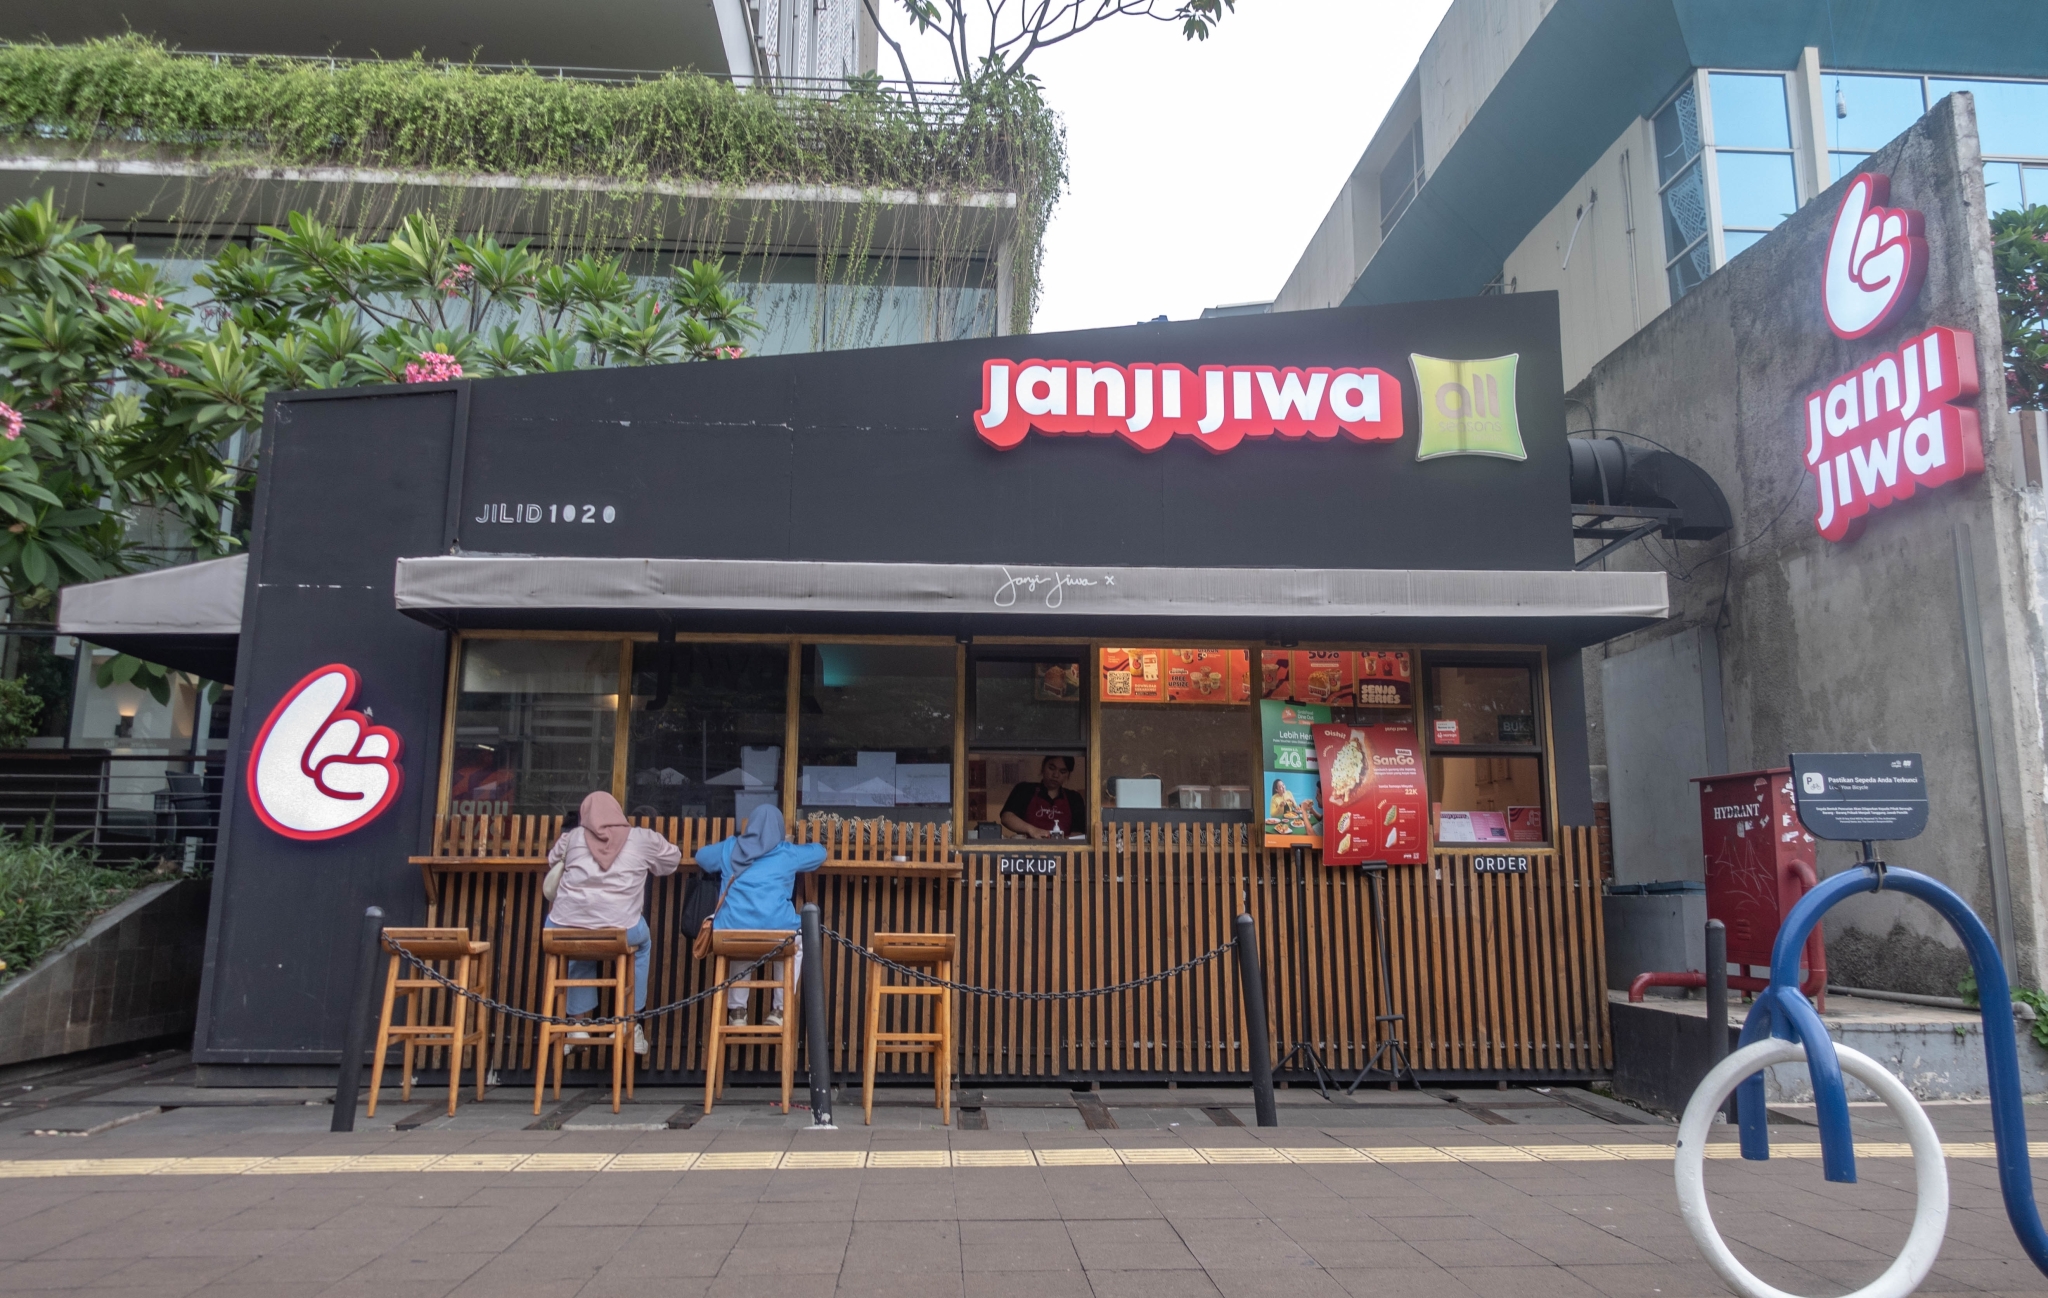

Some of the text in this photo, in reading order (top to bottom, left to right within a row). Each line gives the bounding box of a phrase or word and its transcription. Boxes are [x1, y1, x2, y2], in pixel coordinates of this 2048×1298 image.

[1435, 373, 1500, 420] all
[1439, 421, 1503, 432] seasons
[475, 503, 616, 524] JILID 1020
[1361, 684, 1397, 695] SENJA
[1361, 694, 1401, 704] SERIES
[1279, 731, 1299, 740] Lebih
[1372, 754, 1415, 766] SanGo
[1855, 777, 1877, 785] Sepeda
[1714, 803, 1760, 820] HYDRANT
[1475, 857, 1527, 871] ORDER
